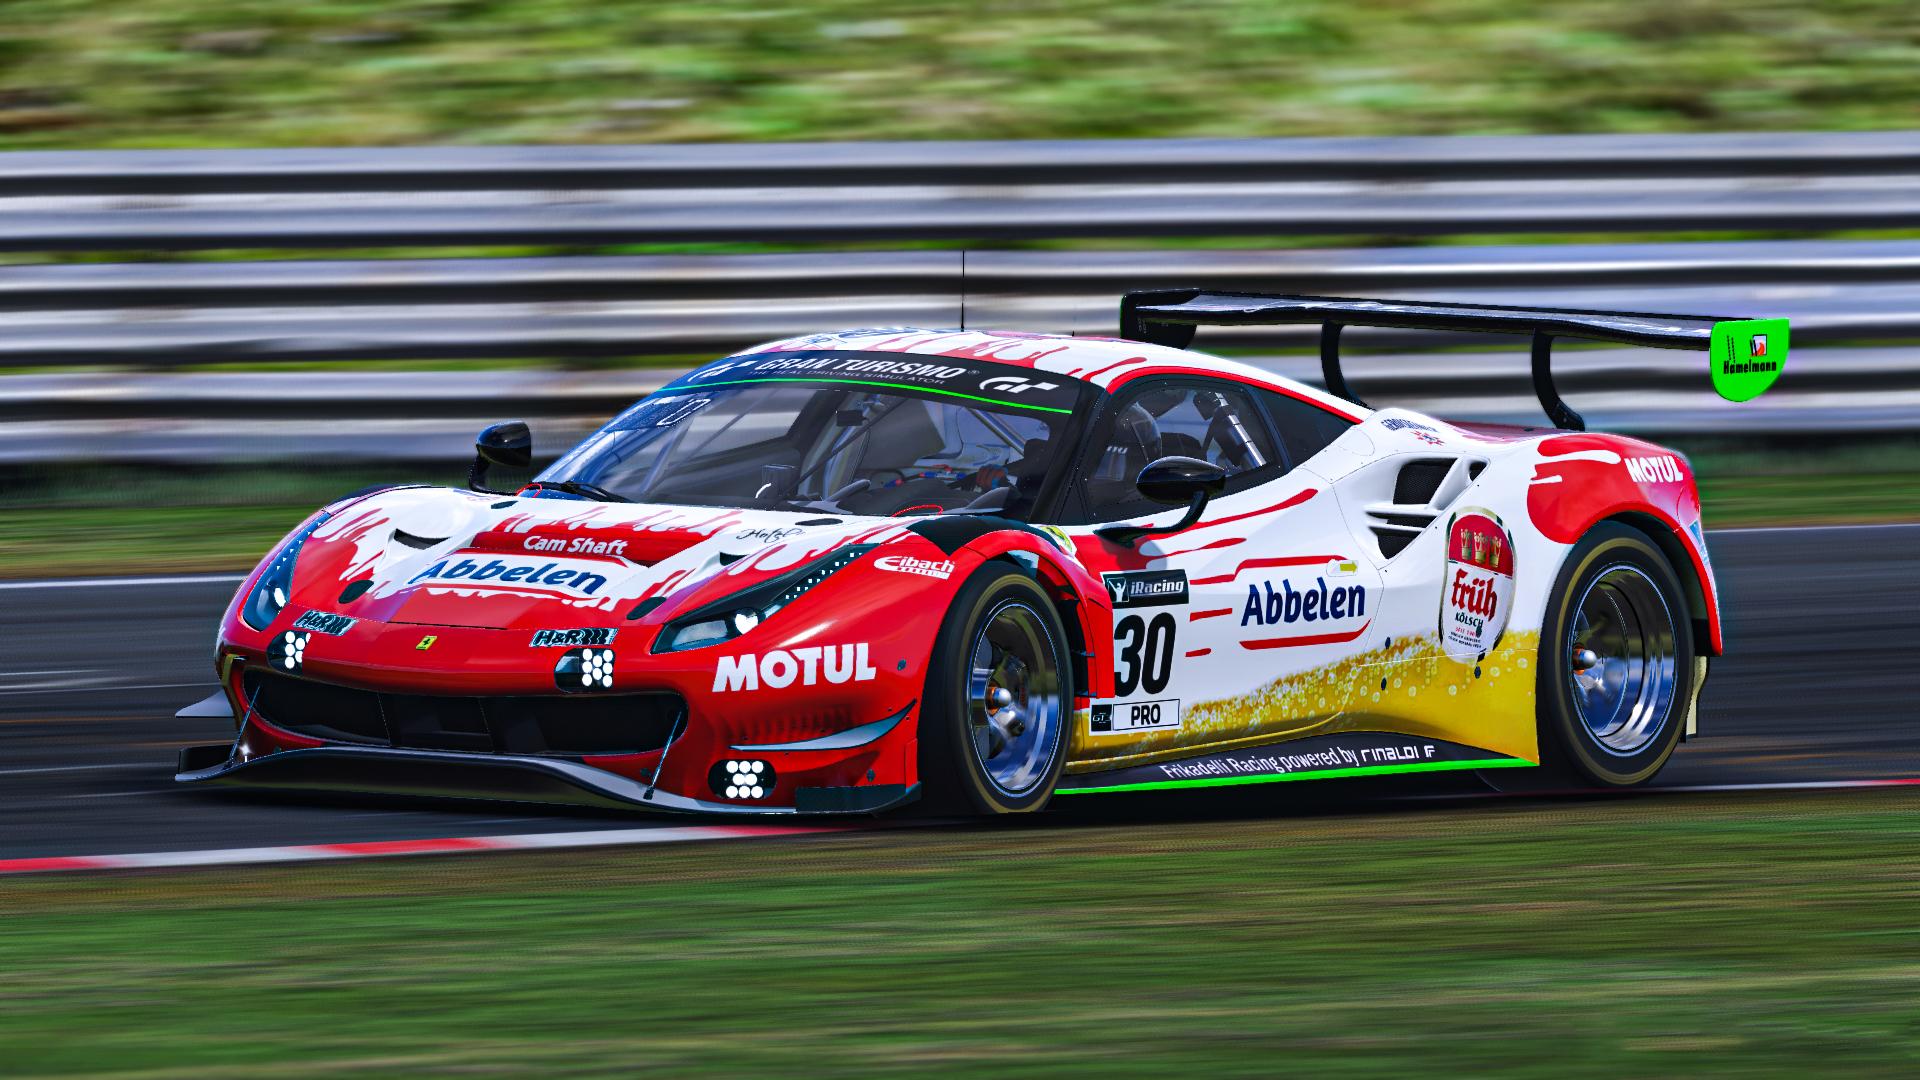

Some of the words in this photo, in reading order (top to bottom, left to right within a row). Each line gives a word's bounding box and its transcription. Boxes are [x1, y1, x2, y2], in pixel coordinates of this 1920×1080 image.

[754, 358, 839, 370] GRAN
[832, 359, 967, 379] TURISMO
[1723, 359, 1777, 375] Hamelmann
[864, 373, 945, 385] SIMULATOR
[1624, 456, 1683, 483] MOTUL
[523, 535, 565, 552] Cam
[566, 537, 629, 556] Shaft
[406, 558, 608, 595] Abbelen
[873, 555, 955, 577] Eibach
[1130, 579, 1184, 596] iRacing
[1240, 577, 1366, 627] Abbelen
[1455, 611, 1484, 628] KÖLSCH
[1114, 611, 1177, 698] 30
[712, 642, 877, 693] MOTUL
[1131, 704, 1160, 726] PRO
[1159, 759, 1232, 778] Frikadelli
[1226, 755, 1286, 773] Racing
[1279, 748, 1341, 772] powered
[1336, 746, 1360, 767] by
